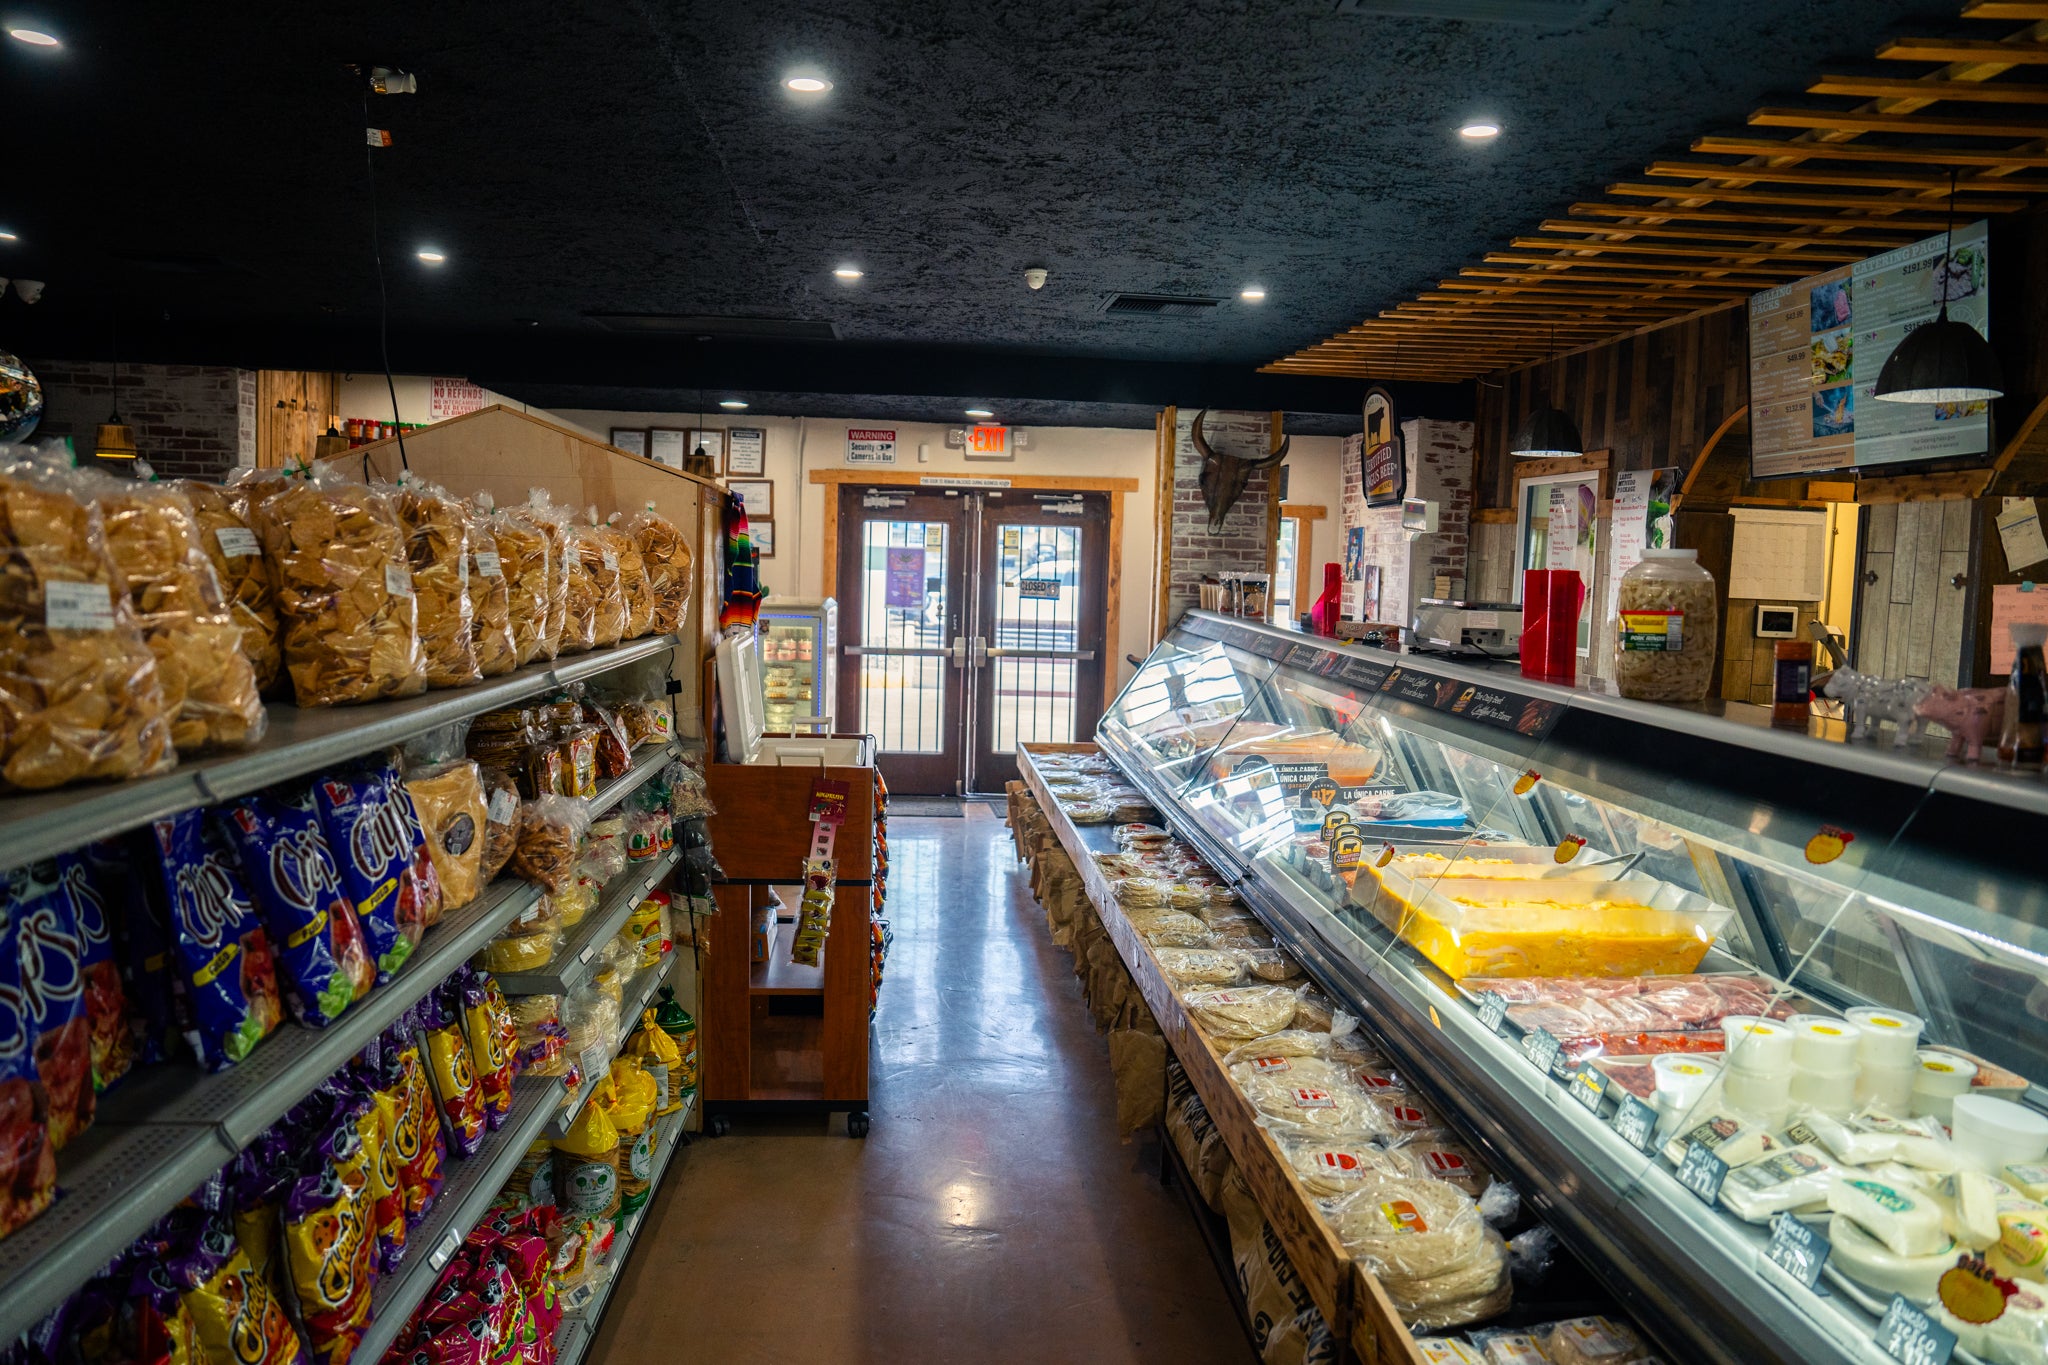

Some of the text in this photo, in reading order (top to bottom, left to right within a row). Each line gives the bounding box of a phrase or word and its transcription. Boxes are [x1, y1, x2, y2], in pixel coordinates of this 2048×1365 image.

[1854, 248, 1911, 275] CATERING
[1902, 258, 1932, 275] $191.99
[1752, 286, 1792, 306] GRILLING
[1752, 299, 1780, 316] PACKS
[434, 388, 484, 400] NO REFUNDS
[850, 431, 893, 441] WARNING
[974, 427, 1007, 452] EXIT
[851, 442, 874, 452] Security
[851, 452, 874, 460] Cameras
[1617, 479, 1636, 487] MENUDO
[1021, 581, 1046, 592] CLOSED
[1279, 772, 1298, 782] ÚNICA
[1320, 788, 1336, 806] 17
[1343, 788, 1395, 799] LA ÚNICA CARNE
[271, 818, 342, 912] Chips
[1891, 1296, 1929, 1332] Queso
[1887, 1311, 1938, 1355] Fresco
